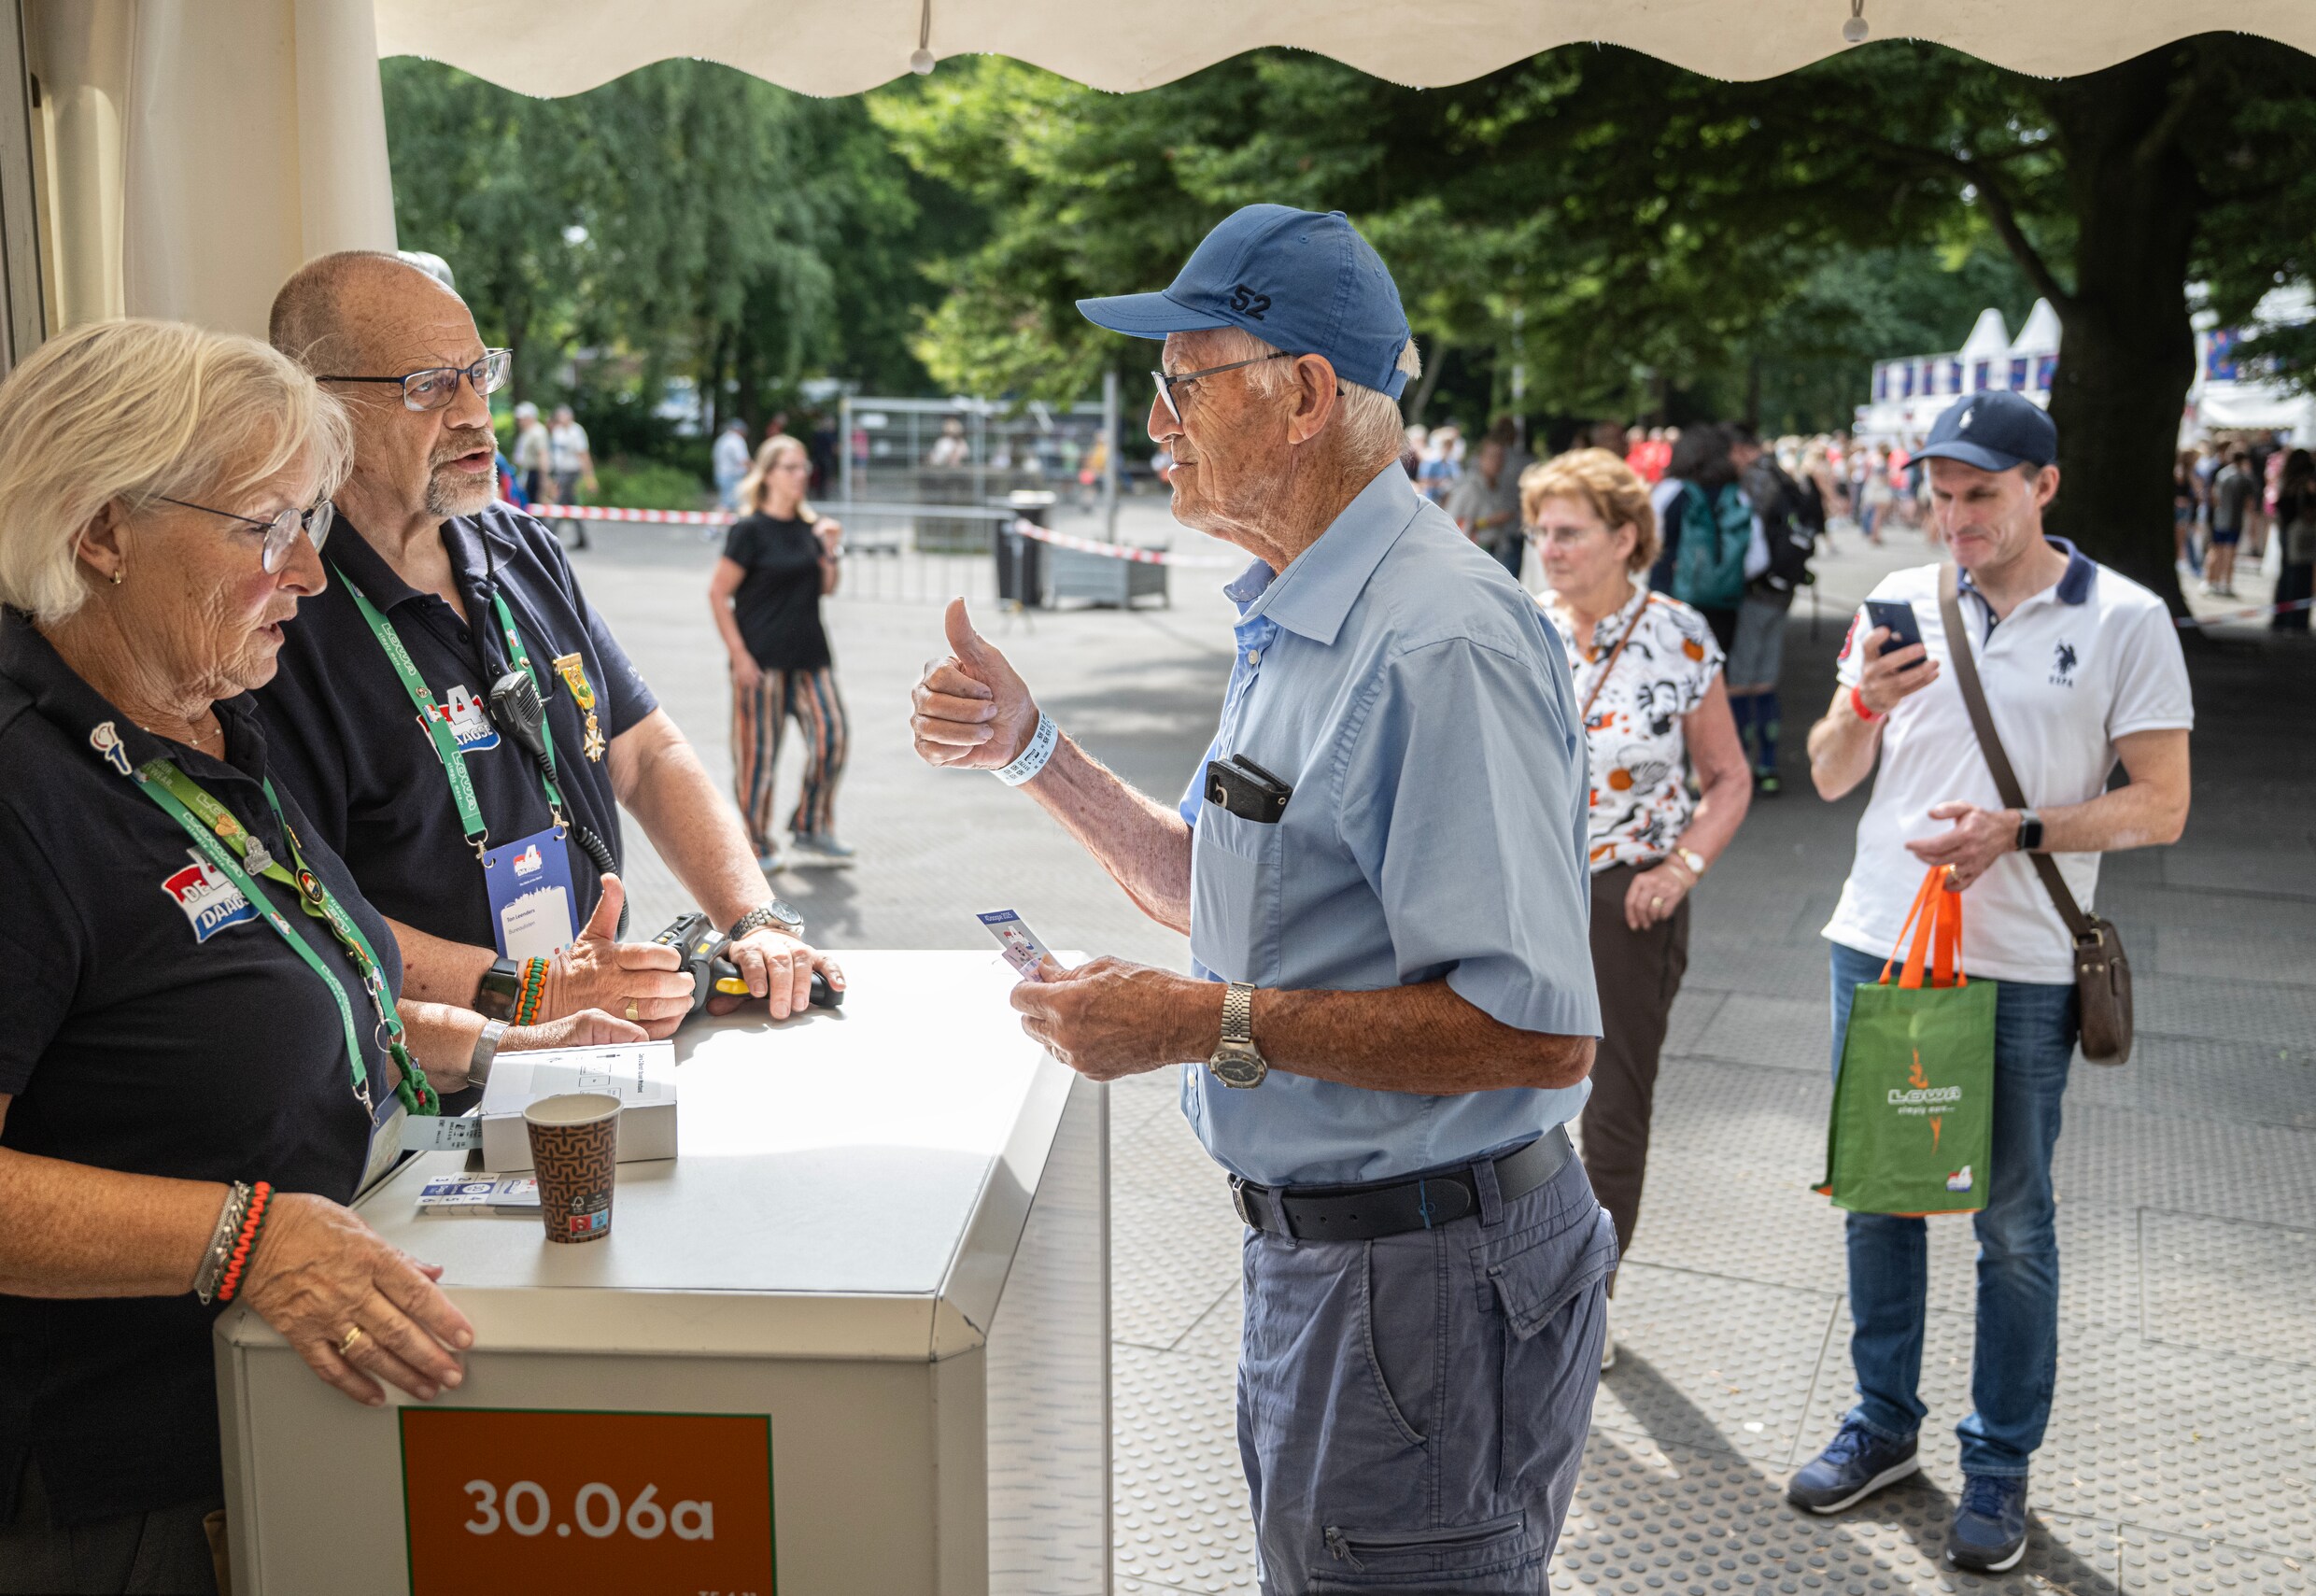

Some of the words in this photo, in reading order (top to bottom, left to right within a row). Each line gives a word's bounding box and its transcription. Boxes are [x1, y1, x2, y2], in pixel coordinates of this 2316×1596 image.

[1230, 284, 1271, 320] 52
[378, 632, 392, 651] simply
[447, 684, 484, 726] 4
[454, 724, 494, 746] AAGSE
[447, 762, 457, 784] simply
[181, 880, 210, 903] DE
[201, 892, 250, 929] DAAG
[463, 1478, 714, 1541] 30.06a
